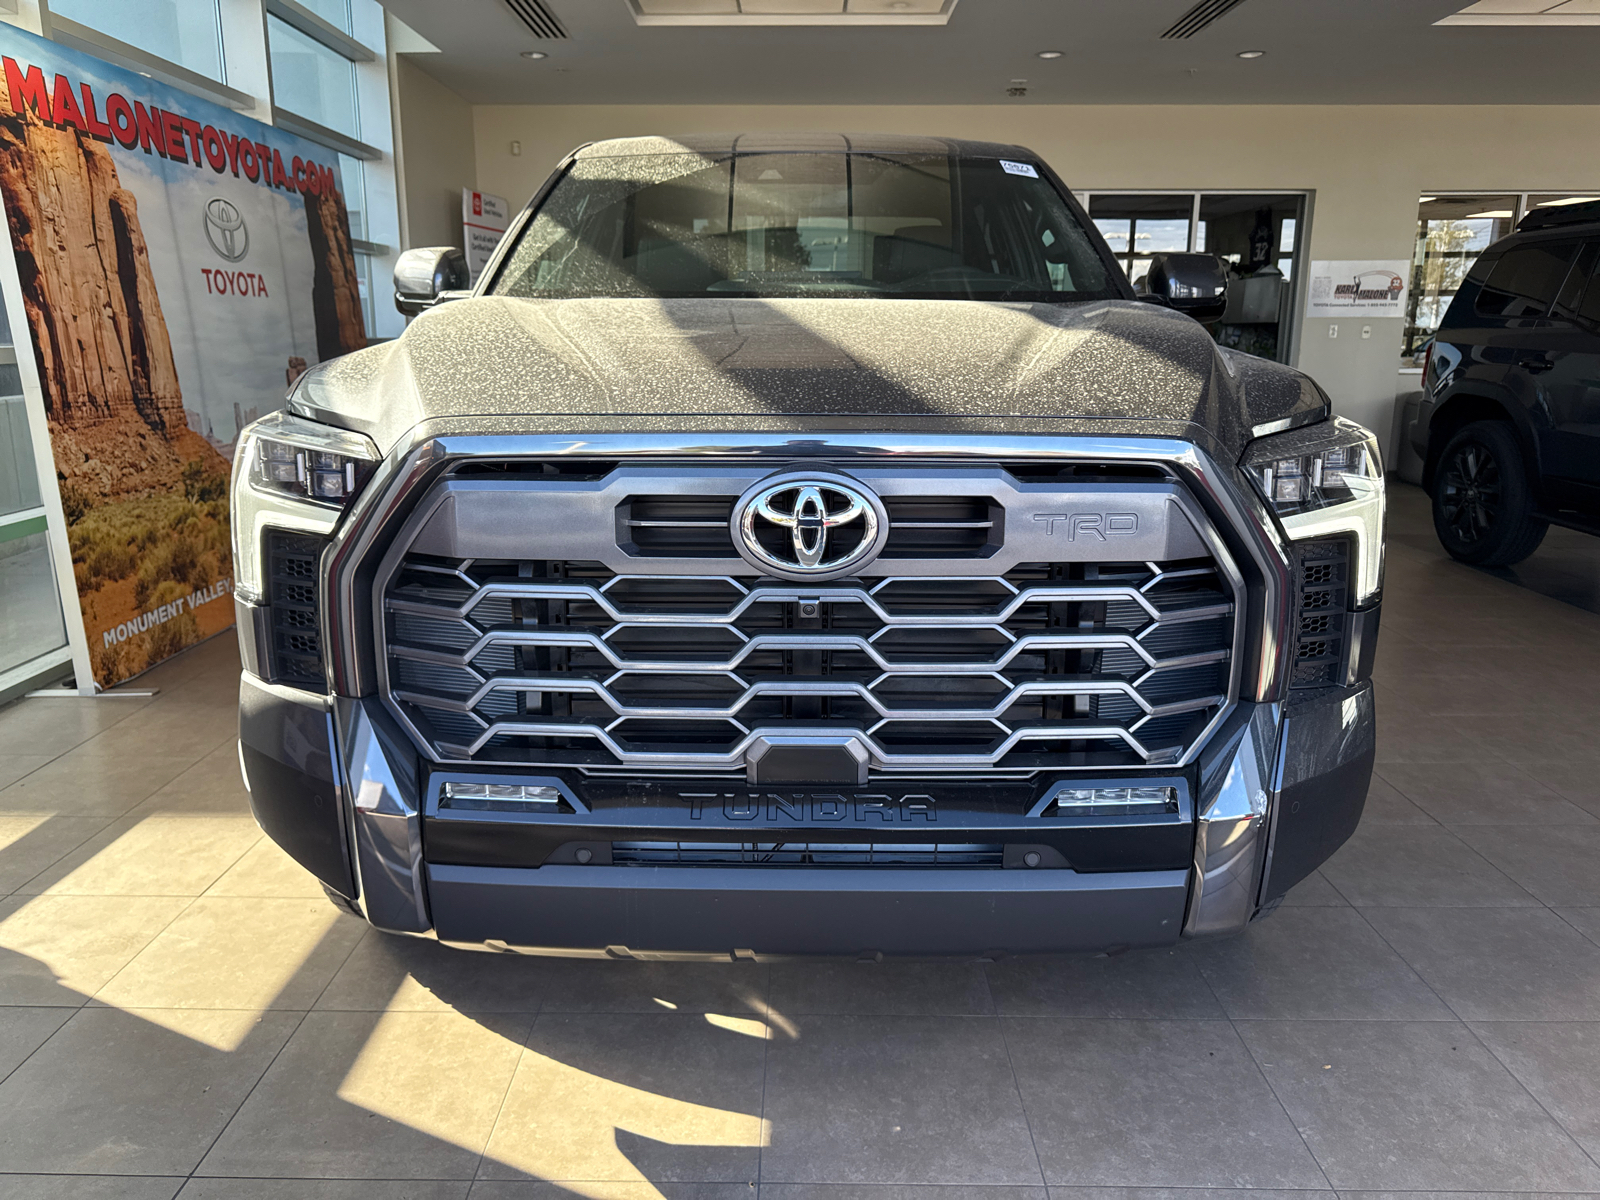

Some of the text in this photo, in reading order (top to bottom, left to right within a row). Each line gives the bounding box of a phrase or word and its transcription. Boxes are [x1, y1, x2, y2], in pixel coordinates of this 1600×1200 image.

[1, 54, 337, 199] MALONETOYOTA.COM
[1253, 242, 1269, 261] 32
[201, 268, 269, 298] TOYOTA
[1334, 284, 1356, 294] KARL
[1358, 290, 1389, 300] MALONE
[1033, 512, 1139, 542] TRD
[102, 577, 234, 649] MONUMENT VALLEY,
[677, 793, 937, 822] TUNDRA
